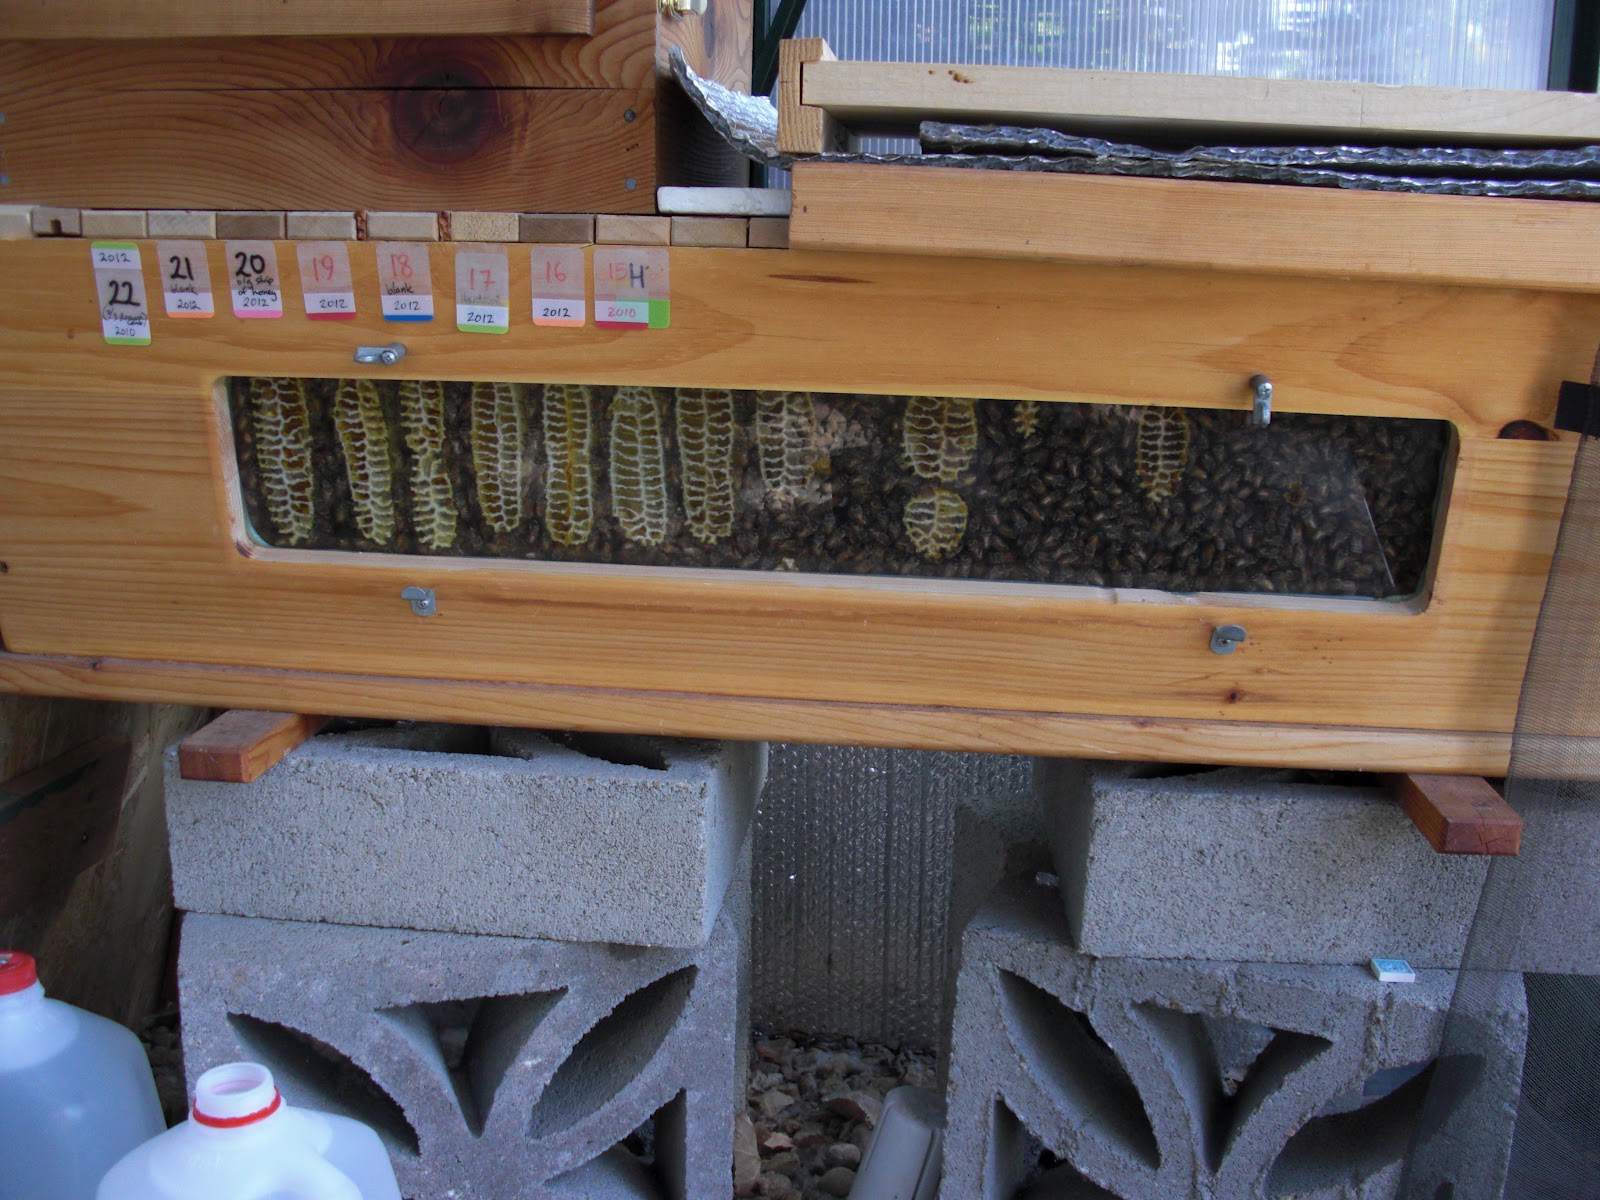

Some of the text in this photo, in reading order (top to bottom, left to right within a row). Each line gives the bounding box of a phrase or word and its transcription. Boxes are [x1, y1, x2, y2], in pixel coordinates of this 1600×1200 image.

[98, 252, 132, 263] 2012
[169, 255, 194, 281] 21
[235, 251, 266, 277] 20
[312, 255, 334, 282] 19
[390, 253, 414, 279] 18
[546, 261, 567, 283] 16
[469, 268, 496, 290] 17
[108, 280, 140, 306] 22
[171, 284, 198, 294] blank
[252, 286, 277, 301] honey
[385, 283, 414, 295] blank
[177, 299, 201, 310] 2012
[243, 297, 269, 307] 2012
[319, 298, 348, 309] 2012
[393, 300, 421, 311] 2012
[467, 312, 495, 324] 2012
[542, 307, 572, 318] 2012
[608, 307, 636, 318] 2010
[115, 327, 136, 337] 2010
